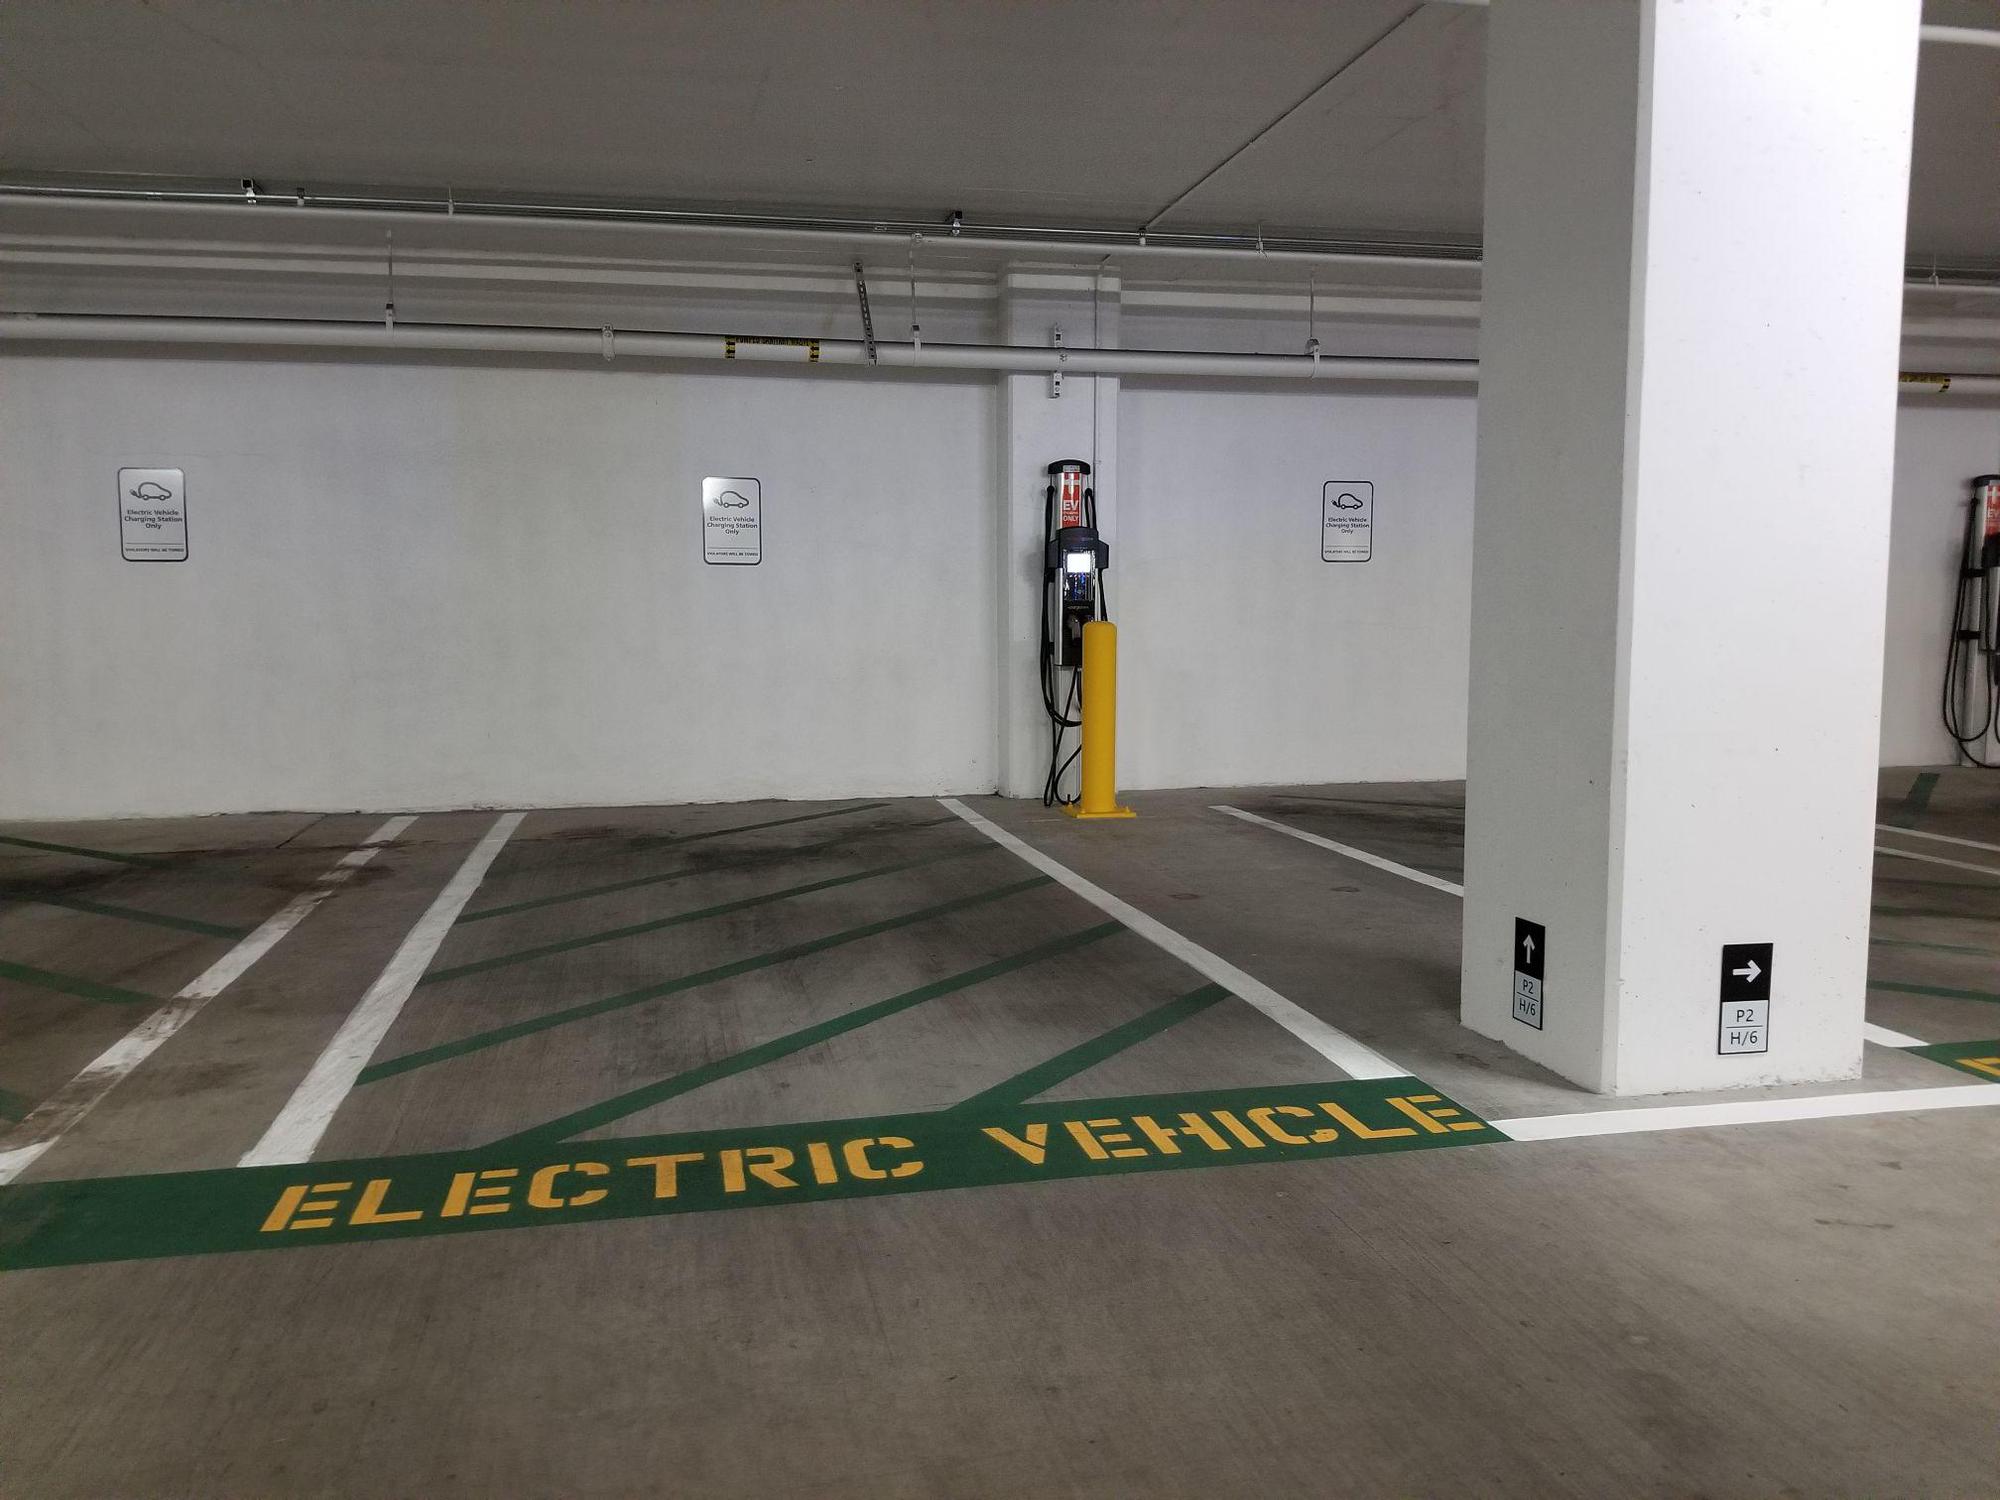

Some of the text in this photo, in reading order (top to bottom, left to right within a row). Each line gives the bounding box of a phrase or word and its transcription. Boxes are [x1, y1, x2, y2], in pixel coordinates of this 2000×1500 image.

[1063, 500, 1079, 511] EV
[1522, 979, 1535, 995] P2
[1519, 1000, 1536, 1016] H/6
[1736, 1009, 1755, 1022] P2
[1730, 1030, 1758, 1046] H/6
[259, 1093, 1487, 1232] ELECTRIC VEHICLE
